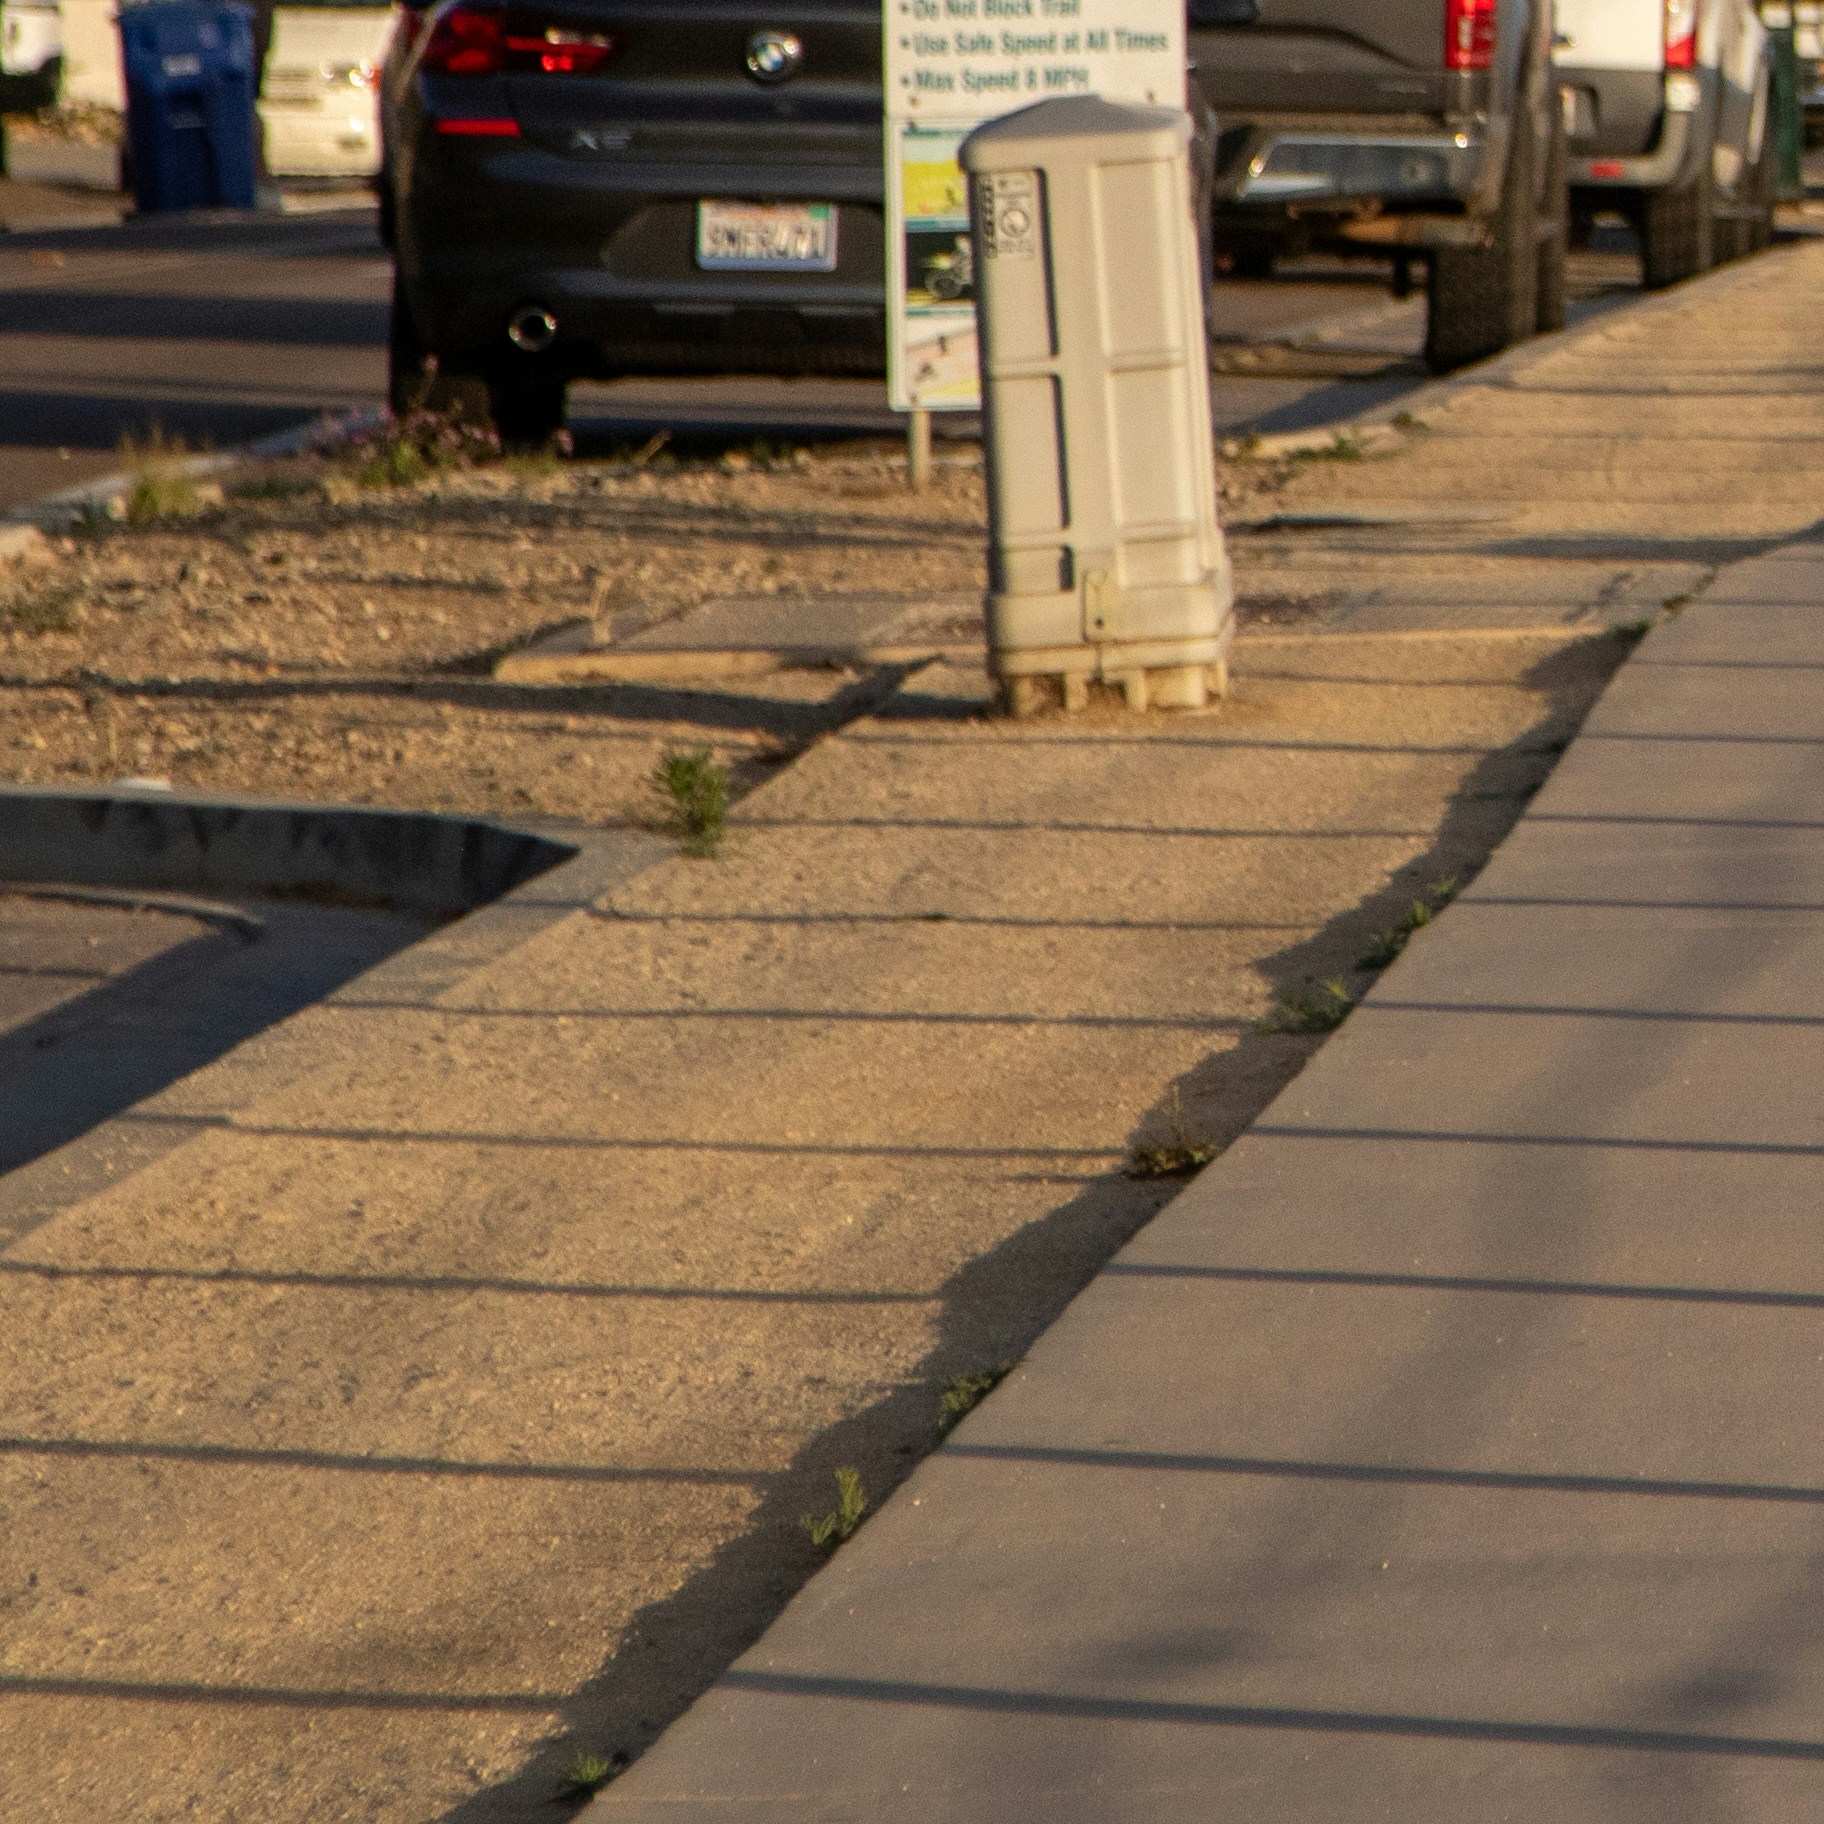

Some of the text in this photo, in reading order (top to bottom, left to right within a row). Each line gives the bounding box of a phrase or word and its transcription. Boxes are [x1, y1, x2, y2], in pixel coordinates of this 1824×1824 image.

[914, 27, 1169, 59] Use Safe Speed at All Times
[915, 69, 955, 93] Max
[960, 67, 1019, 95] Speed
[1043, 66, 1089, 92] MPH
